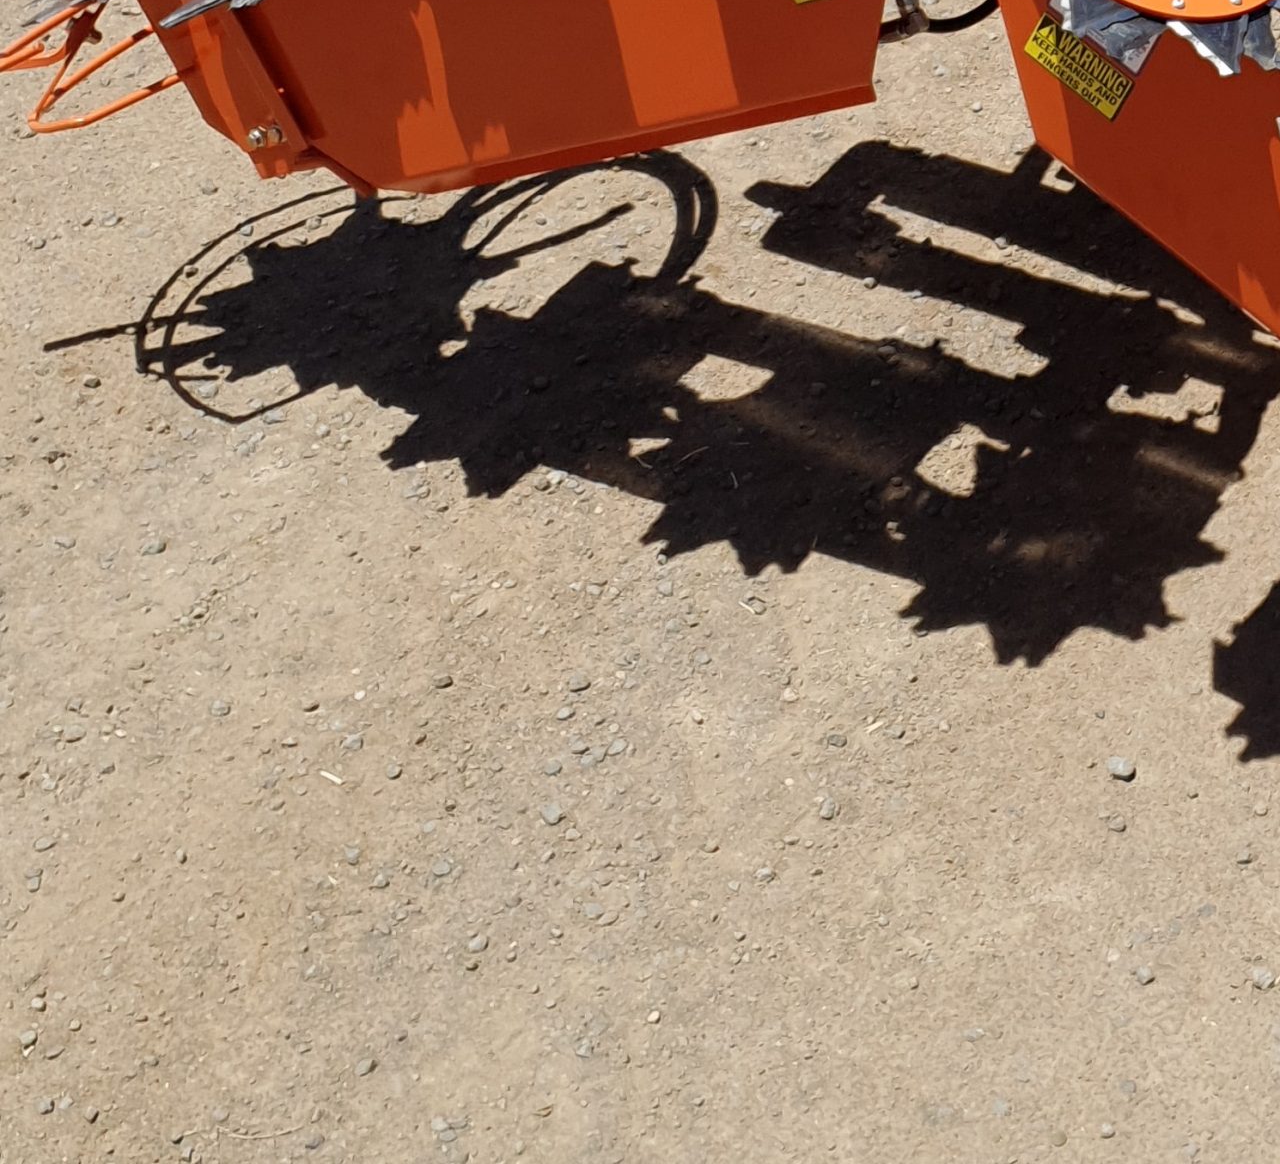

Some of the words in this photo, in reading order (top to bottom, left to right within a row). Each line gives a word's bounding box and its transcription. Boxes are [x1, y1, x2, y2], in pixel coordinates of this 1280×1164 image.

[1032, 34, 1058, 56] KEEP
[1059, 56, 1094, 87] HANDS
[1096, 85, 1117, 106] AND
[1038, 53, 1080, 89] FINGERS
[1081, 88, 1103, 107] OUT
[1059, 30, 1127, 95] WARNING
